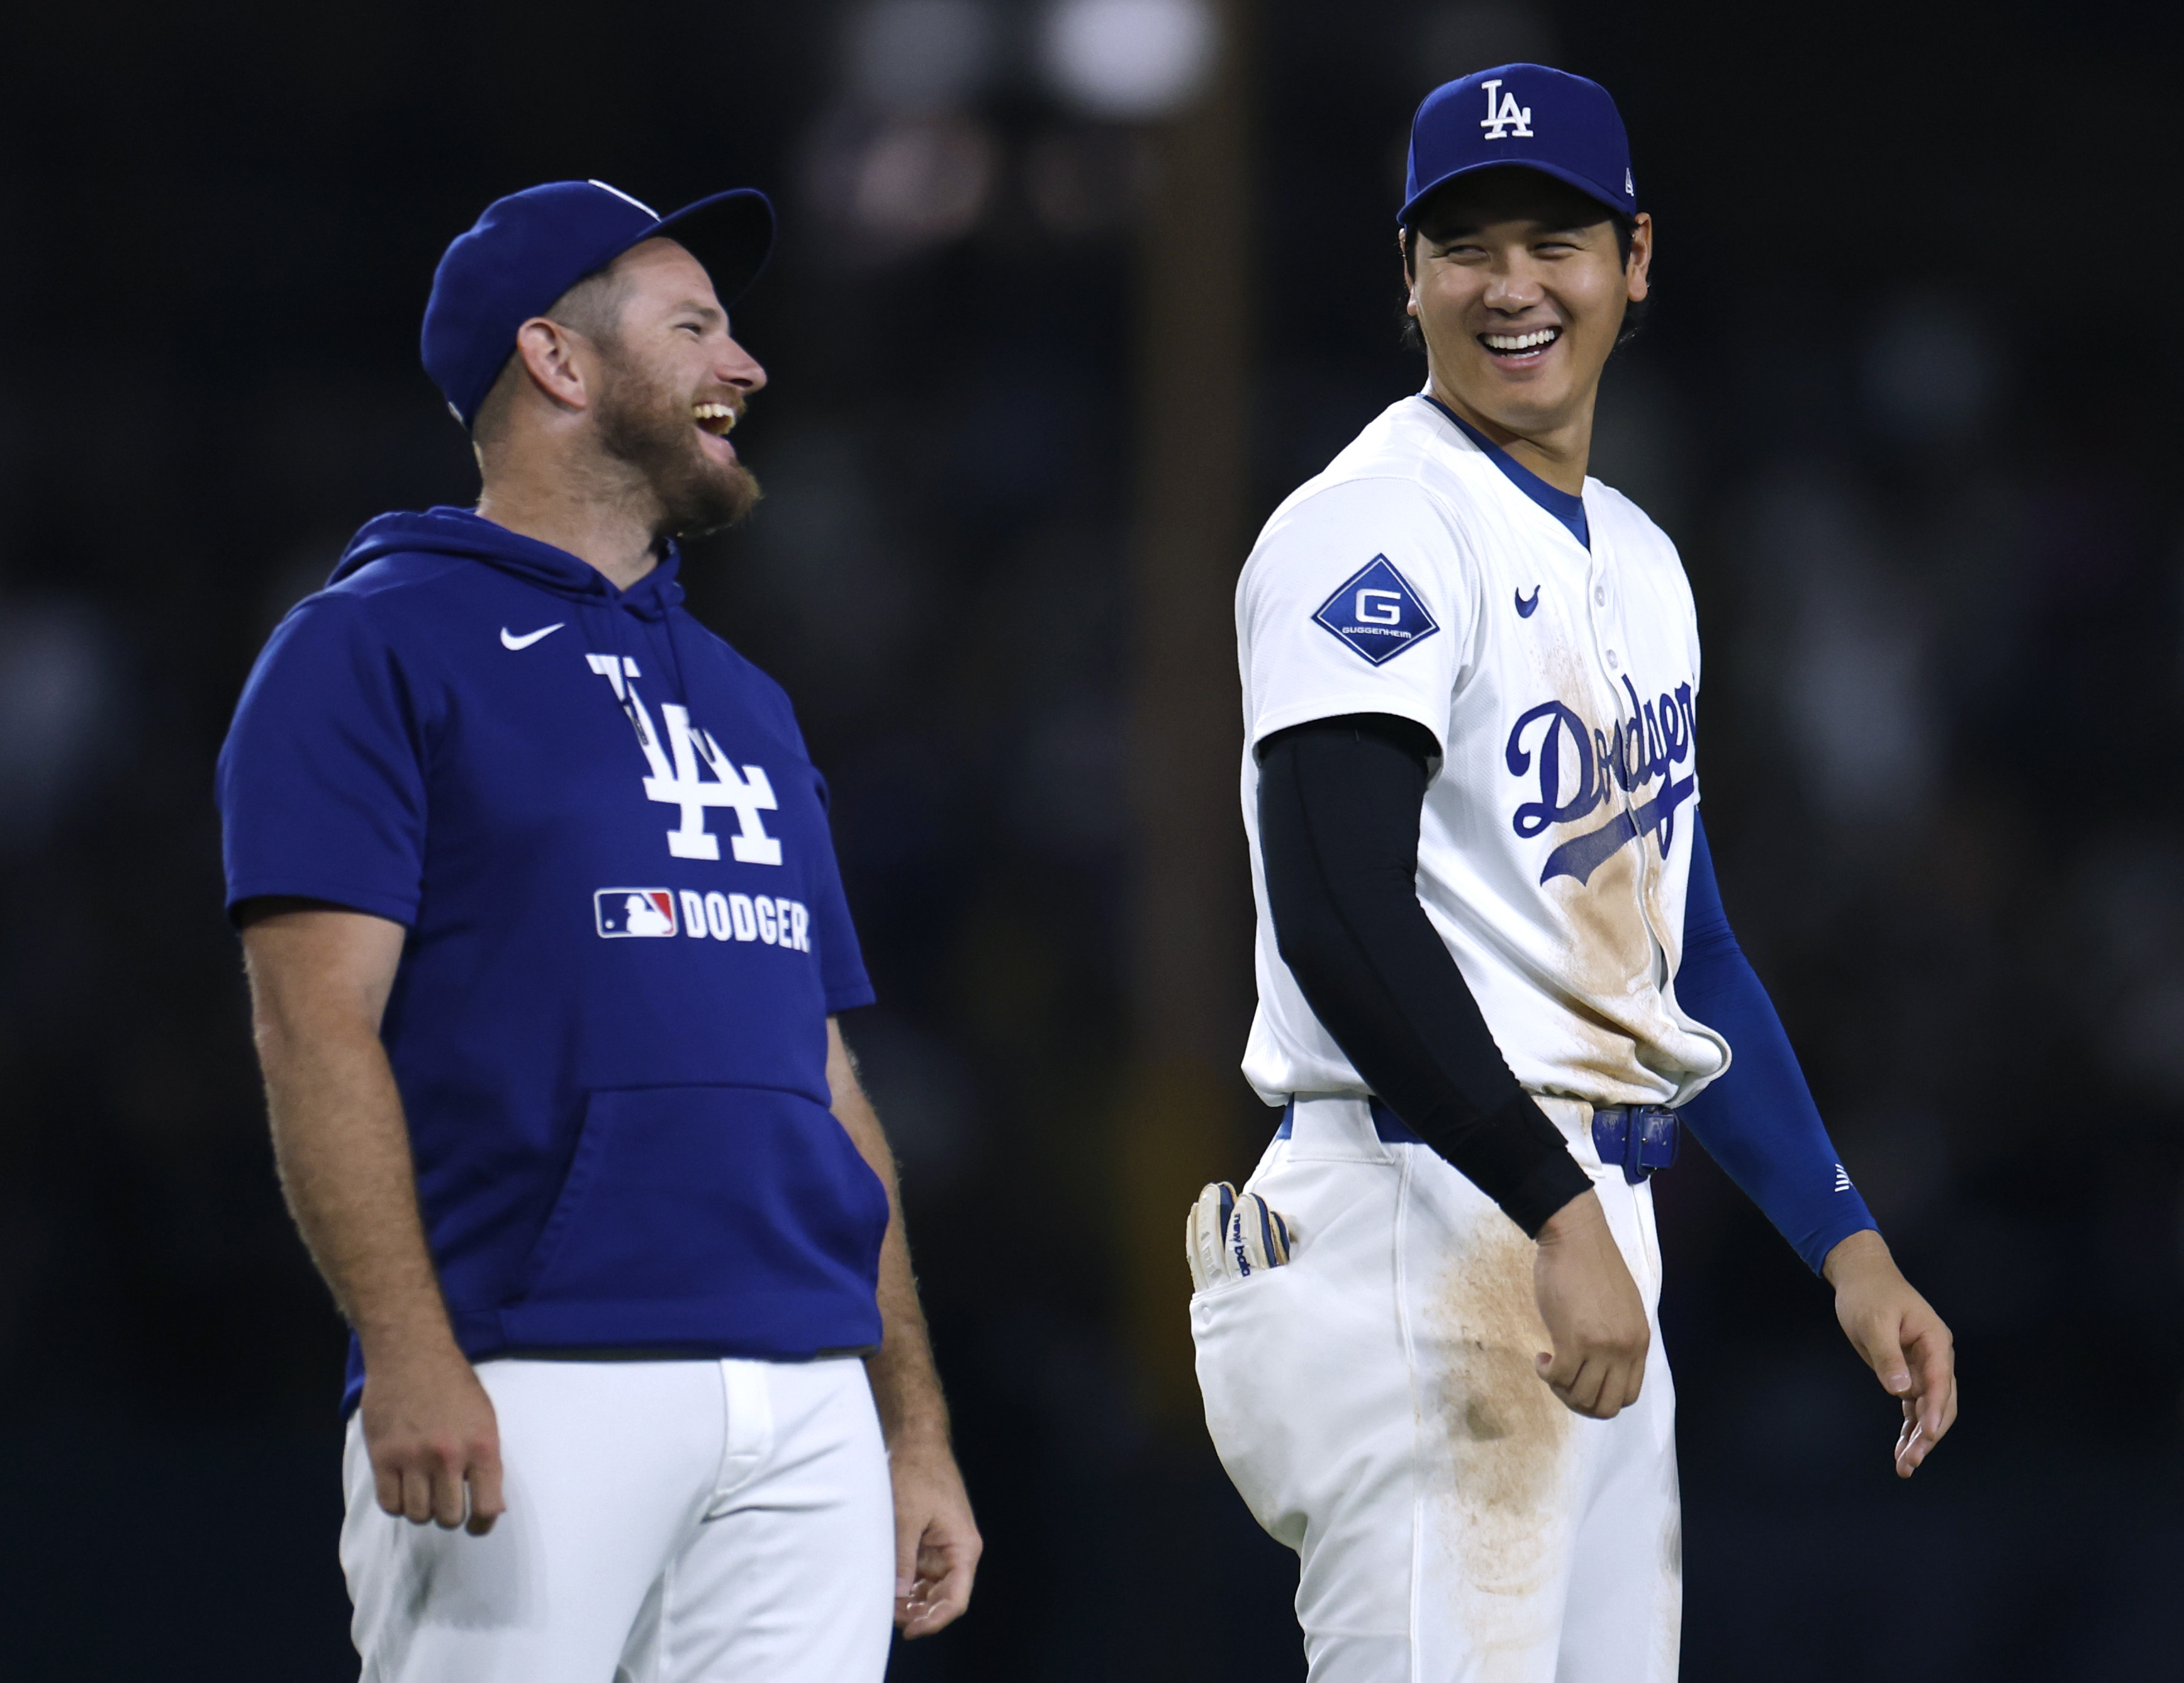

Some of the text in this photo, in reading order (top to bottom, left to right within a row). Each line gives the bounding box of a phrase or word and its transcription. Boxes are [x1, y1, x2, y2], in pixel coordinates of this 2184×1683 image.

[1481, 79, 1534, 140] LA
[1355, 588, 1401, 626] G
[1341, 626, 1412, 639] GUGGENHEIM
[585, 653, 783, 867] LA
[1233, 1213, 1242, 1243] new
